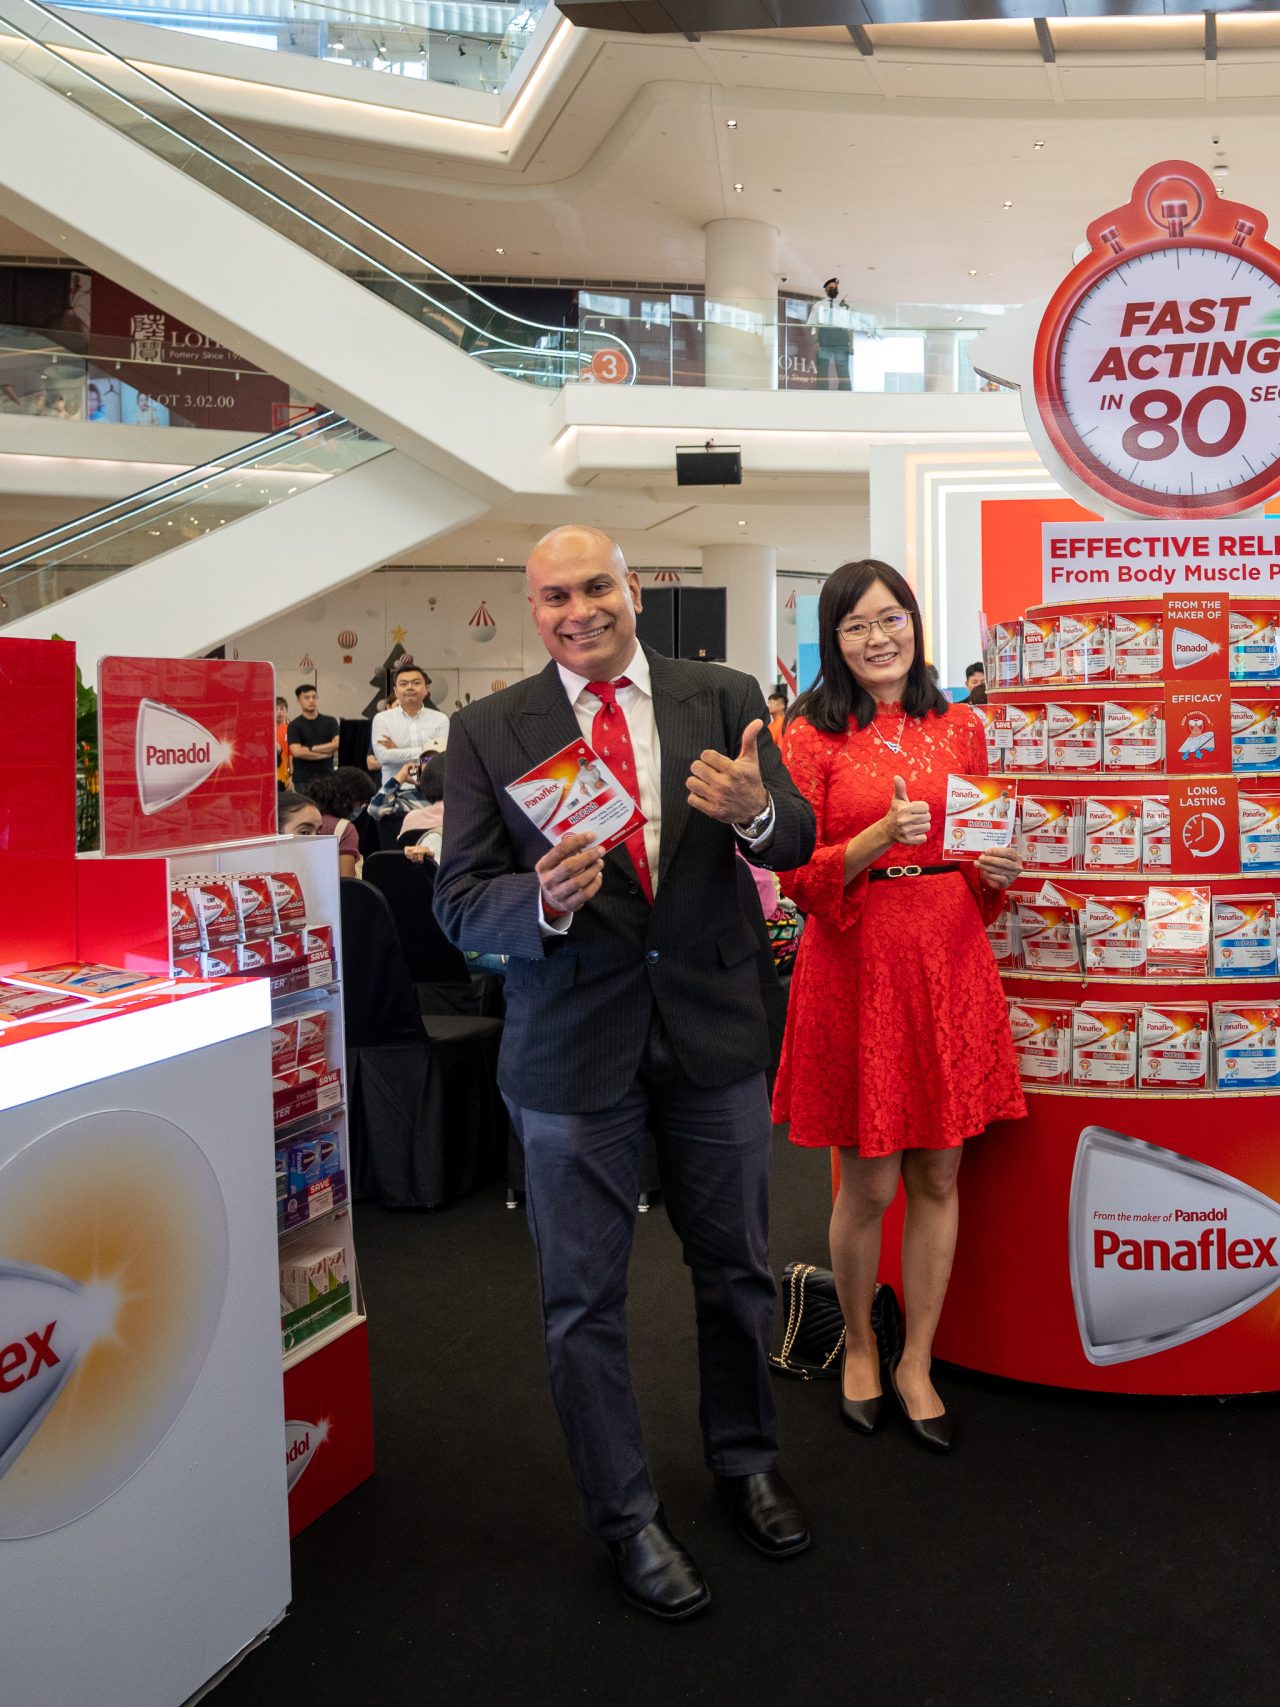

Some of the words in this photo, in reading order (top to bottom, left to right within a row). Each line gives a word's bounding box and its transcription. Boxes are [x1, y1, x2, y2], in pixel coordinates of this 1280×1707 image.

[1120, 296, 1252, 338] FAST
[169, 350, 199, 361] Pottery
[202, 350, 224, 360] Since
[601, 354, 618, 380] 3
[184, 394, 235, 408] 3.02.00
[1099, 393, 1123, 411] IN
[1121, 385, 1247, 462] 80
[1050, 537, 1209, 559] EFFECTIVE
[1051, 566, 1110, 584] From
[1117, 563, 1175, 587] Body
[1184, 562, 1261, 582] Muscle
[1168, 601, 1198, 609] FROM
[1201, 600, 1221, 609] THE
[1168, 611, 1204, 619] MAKER
[1207, 611, 1222, 619] OF
[1026, 634, 1043, 644] SAVE
[1176, 643, 1208, 652] Panadol
[1171, 693, 1223, 704] EFFICACY
[995, 721, 1012, 729] SAVE
[146, 742, 210, 766] Panadol
[524, 783, 561, 809] Panaflex
[951, 790, 980, 799] Panaflex
[1187, 786, 1217, 796] LONG
[1179, 796, 1226, 807] LASTING
[568, 811, 584, 825] Hot
[581, 802, 598, 818] Patch
[1021, 917, 1045, 926] Panaflex
[1089, 913, 1115, 922] Panaflex
[310, 951, 330, 962] SAVE
[1011, 1019, 1034, 1028] Panaflex
[1077, 1024, 1103, 1033] Panaflex
[1147, 1022, 1174, 1032] Panaflex
[319, 1072, 337, 1086] SAVE
[309, 1178, 330, 1194] SAVE
[1093, 1210, 1116, 1221] From
[1117, 1211, 1131, 1222] the
[1132, 1211, 1161, 1222] maker
[1162, 1212, 1174, 1222] of
[1174, 1207, 1228, 1222] Panadol
[1093, 1227, 1279, 1271] Panaflex
